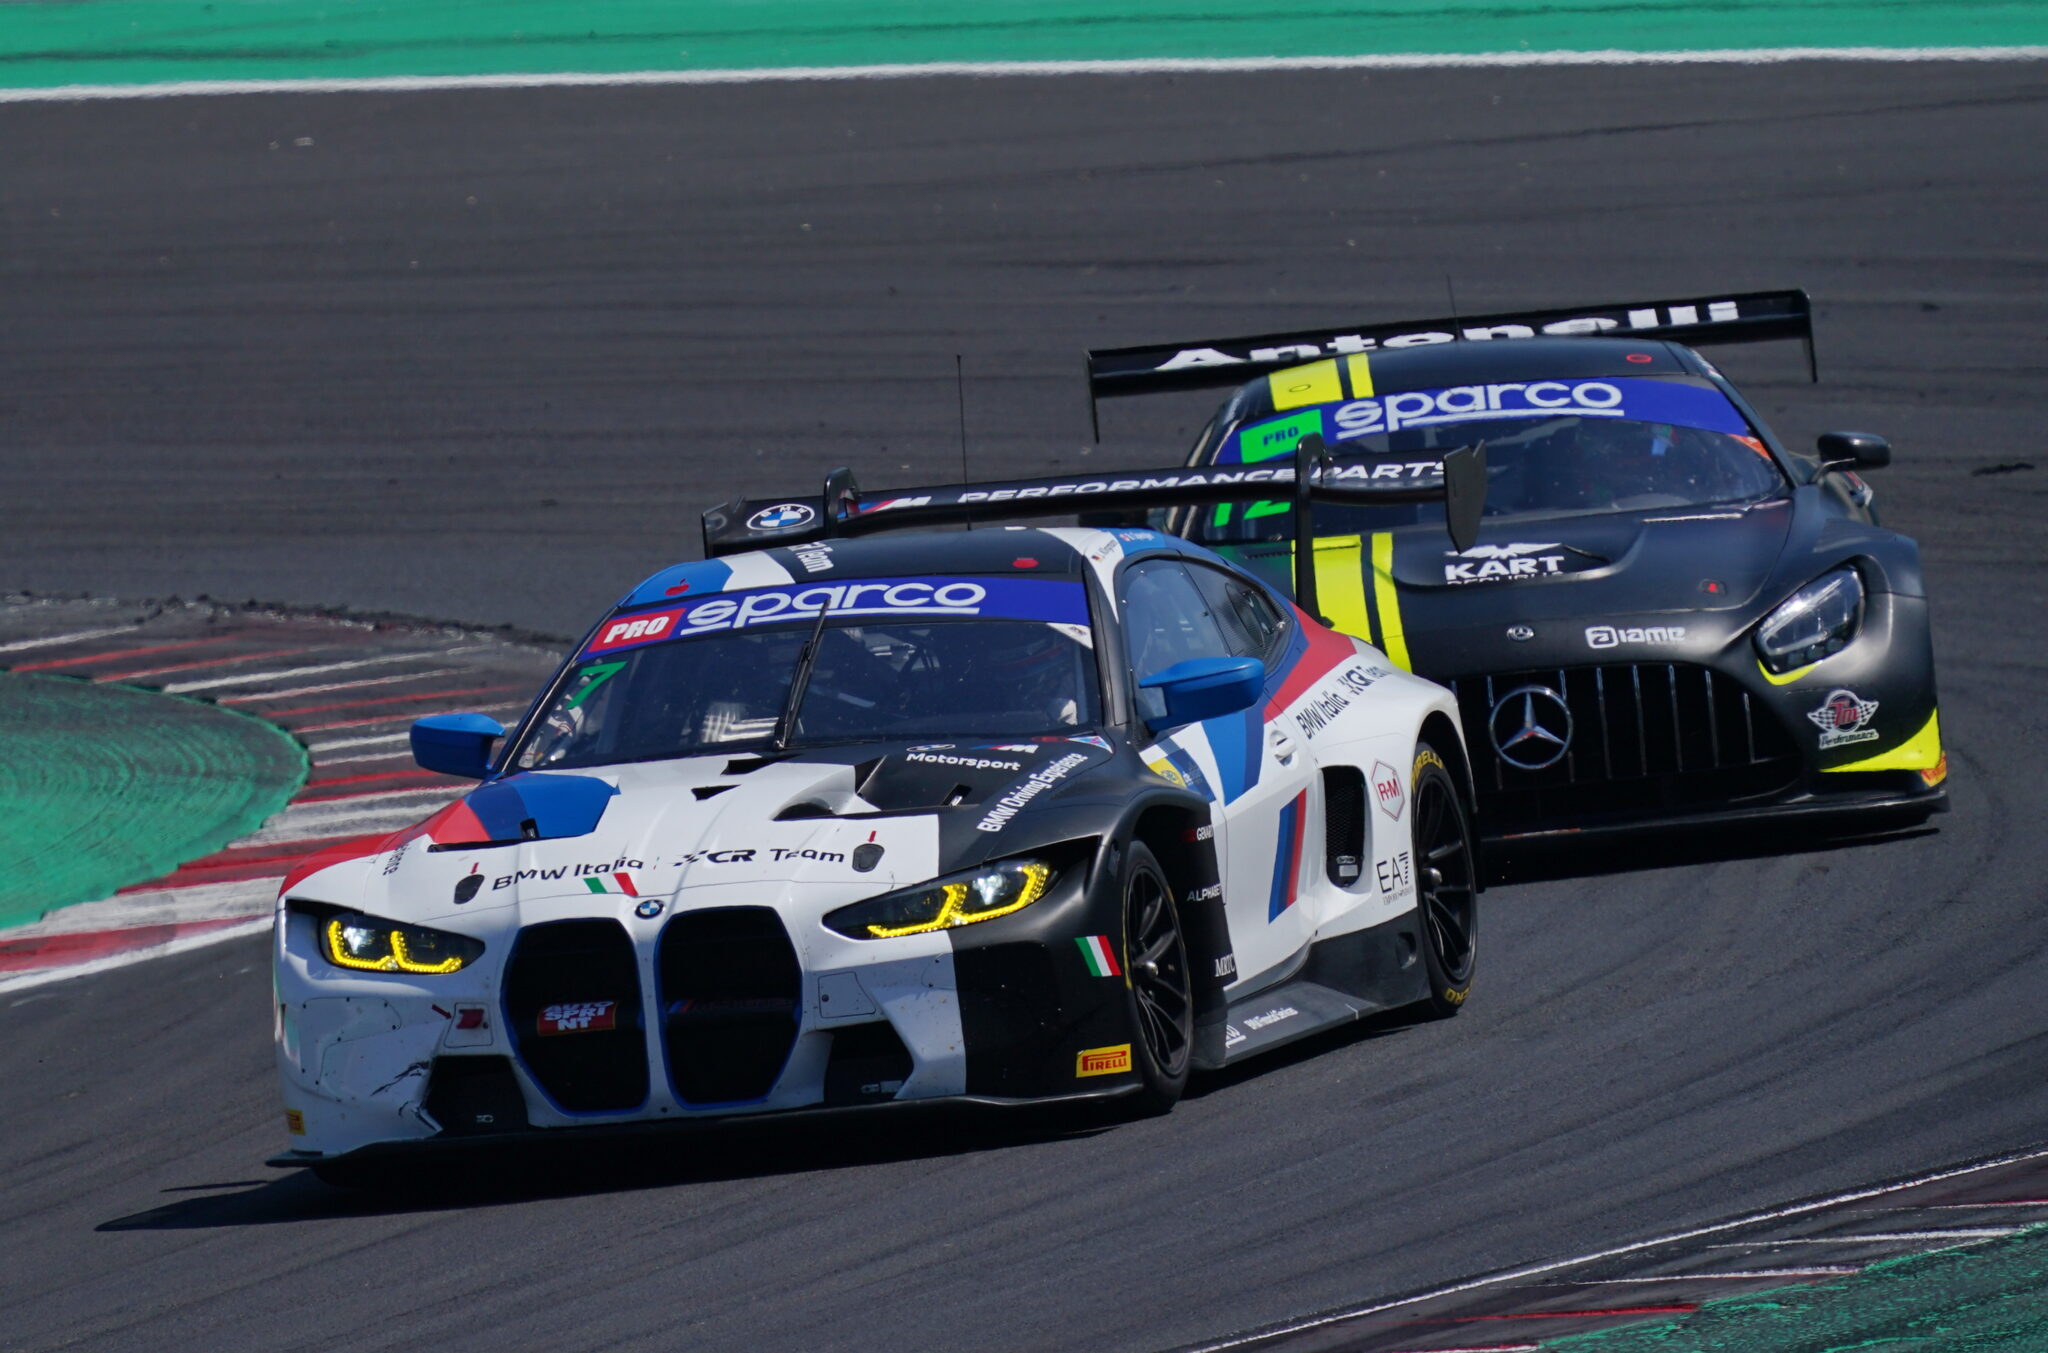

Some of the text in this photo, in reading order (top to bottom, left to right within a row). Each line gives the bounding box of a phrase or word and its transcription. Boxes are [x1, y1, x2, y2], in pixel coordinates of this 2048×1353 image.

[1154, 301, 1738, 370] Antonelli
[1334, 382, 1623, 433] sparco
[1263, 426, 1299, 446] PRO
[957, 467, 1297, 503] PERFORMANCE
[1444, 555, 1564, 581] KART
[685, 582, 986, 630] sparco
[603, 616, 669, 644] PRO
[1295, 702, 1327, 740] BMW
[1314, 690, 1350, 721] Italia
[906, 752, 1021, 771] Motorsport
[976, 803, 1019, 832] BMW
[1000, 779, 1053, 808] Driving
[492, 865, 568, 891] BMW
[573, 856, 644, 878] Italia
[769, 848, 845, 863] Team
[557, 1016, 592, 1032] NT
[1082, 1050, 1127, 1072] PIRELLI
